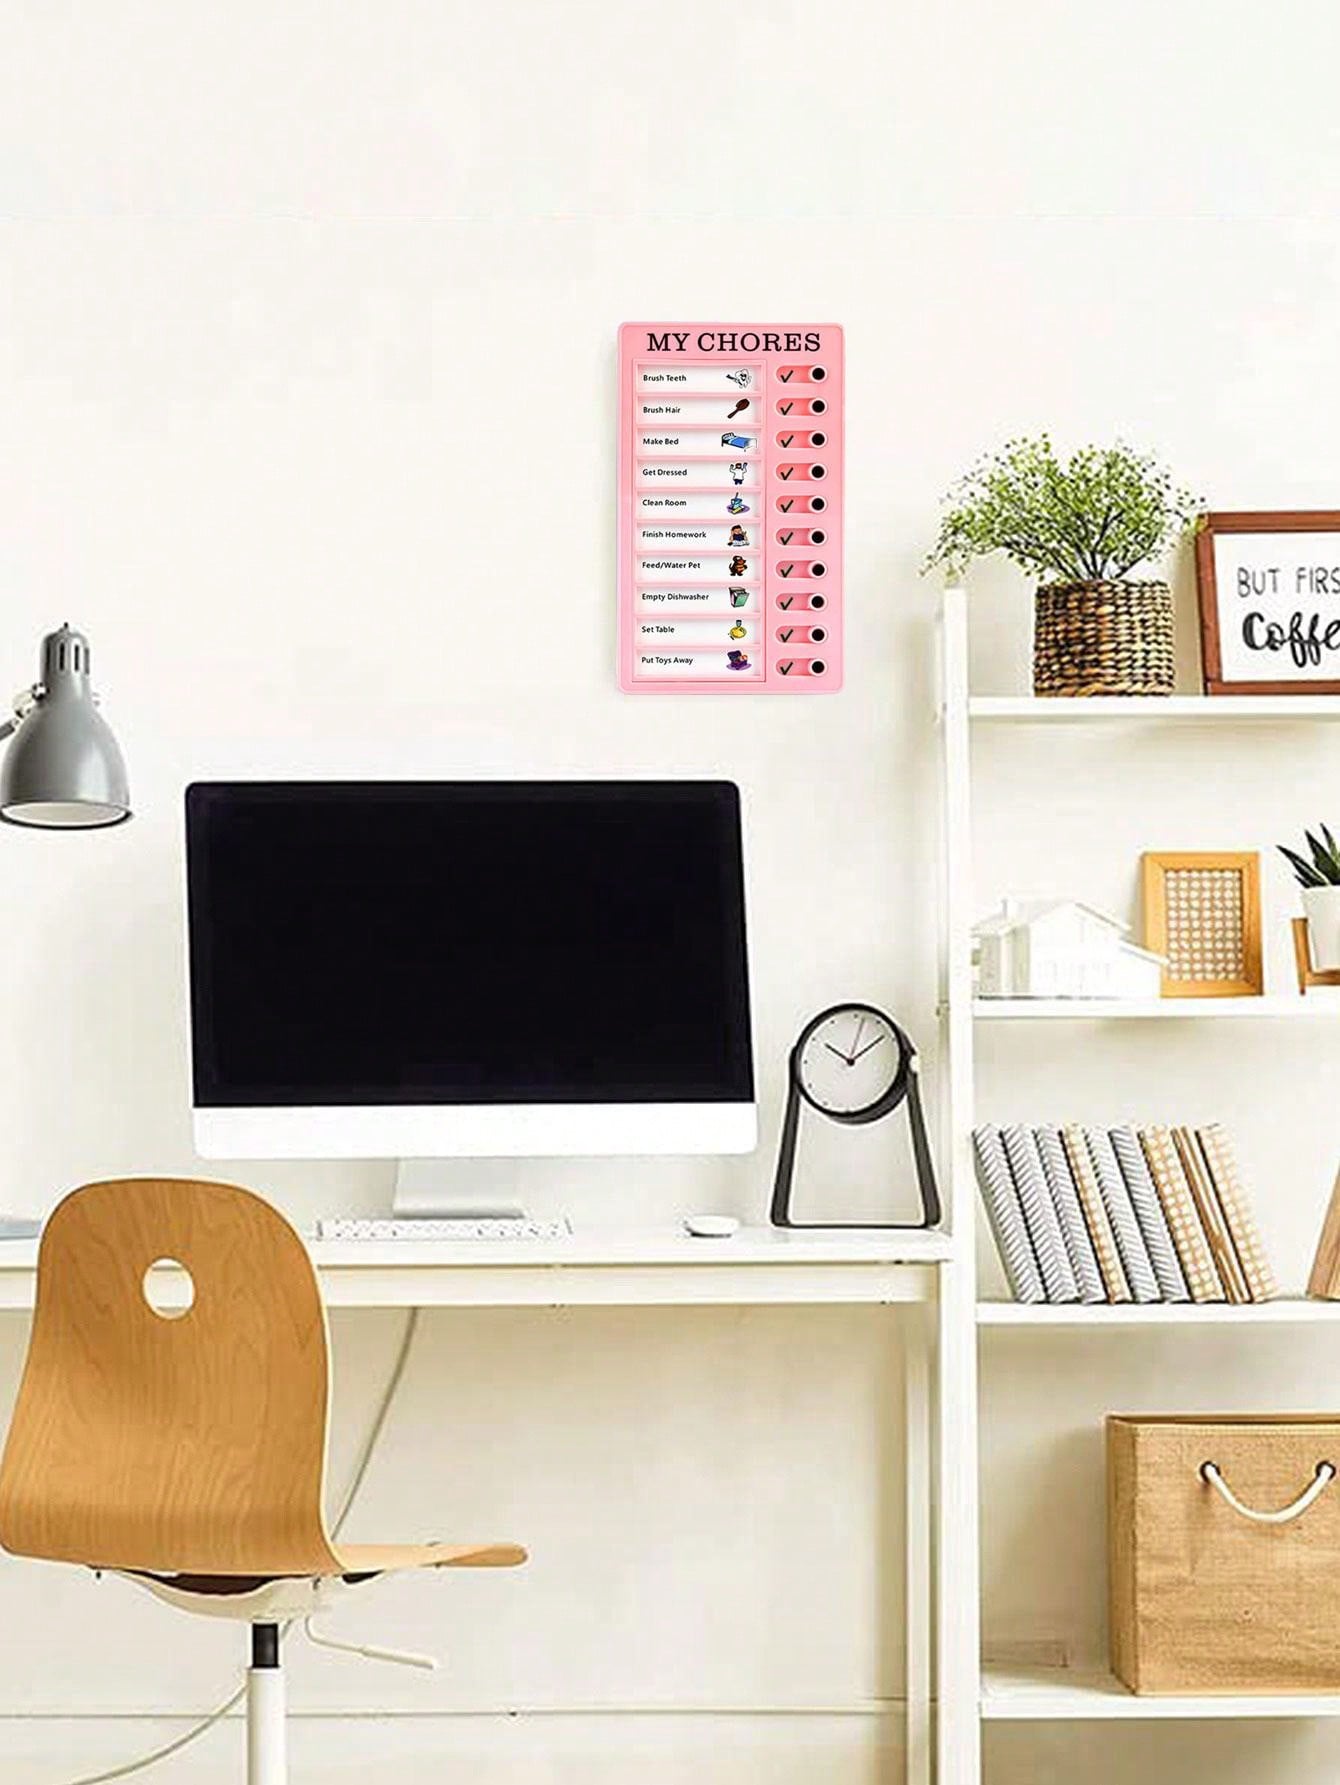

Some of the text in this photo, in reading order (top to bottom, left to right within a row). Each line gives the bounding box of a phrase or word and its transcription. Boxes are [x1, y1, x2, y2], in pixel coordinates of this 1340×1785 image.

[647, 333, 821, 352] MY CHORES
[643, 374, 687, 382] Brush Teeth
[643, 406, 681, 414] Brush Hair
[643, 437, 679, 445] Make Bed
[642, 468, 688, 476] Get Dressed
[642, 499, 687, 507] Clean Room
[642, 530, 707, 539] Finish Homework
[642, 561, 701, 569] Feed/Water Pet
[1237, 567, 1281, 598] BUT
[642, 593, 709, 602] Empty Dishwasher
[641, 625, 675, 633] Set Table
[641, 656, 694, 665] Put Toys Away
